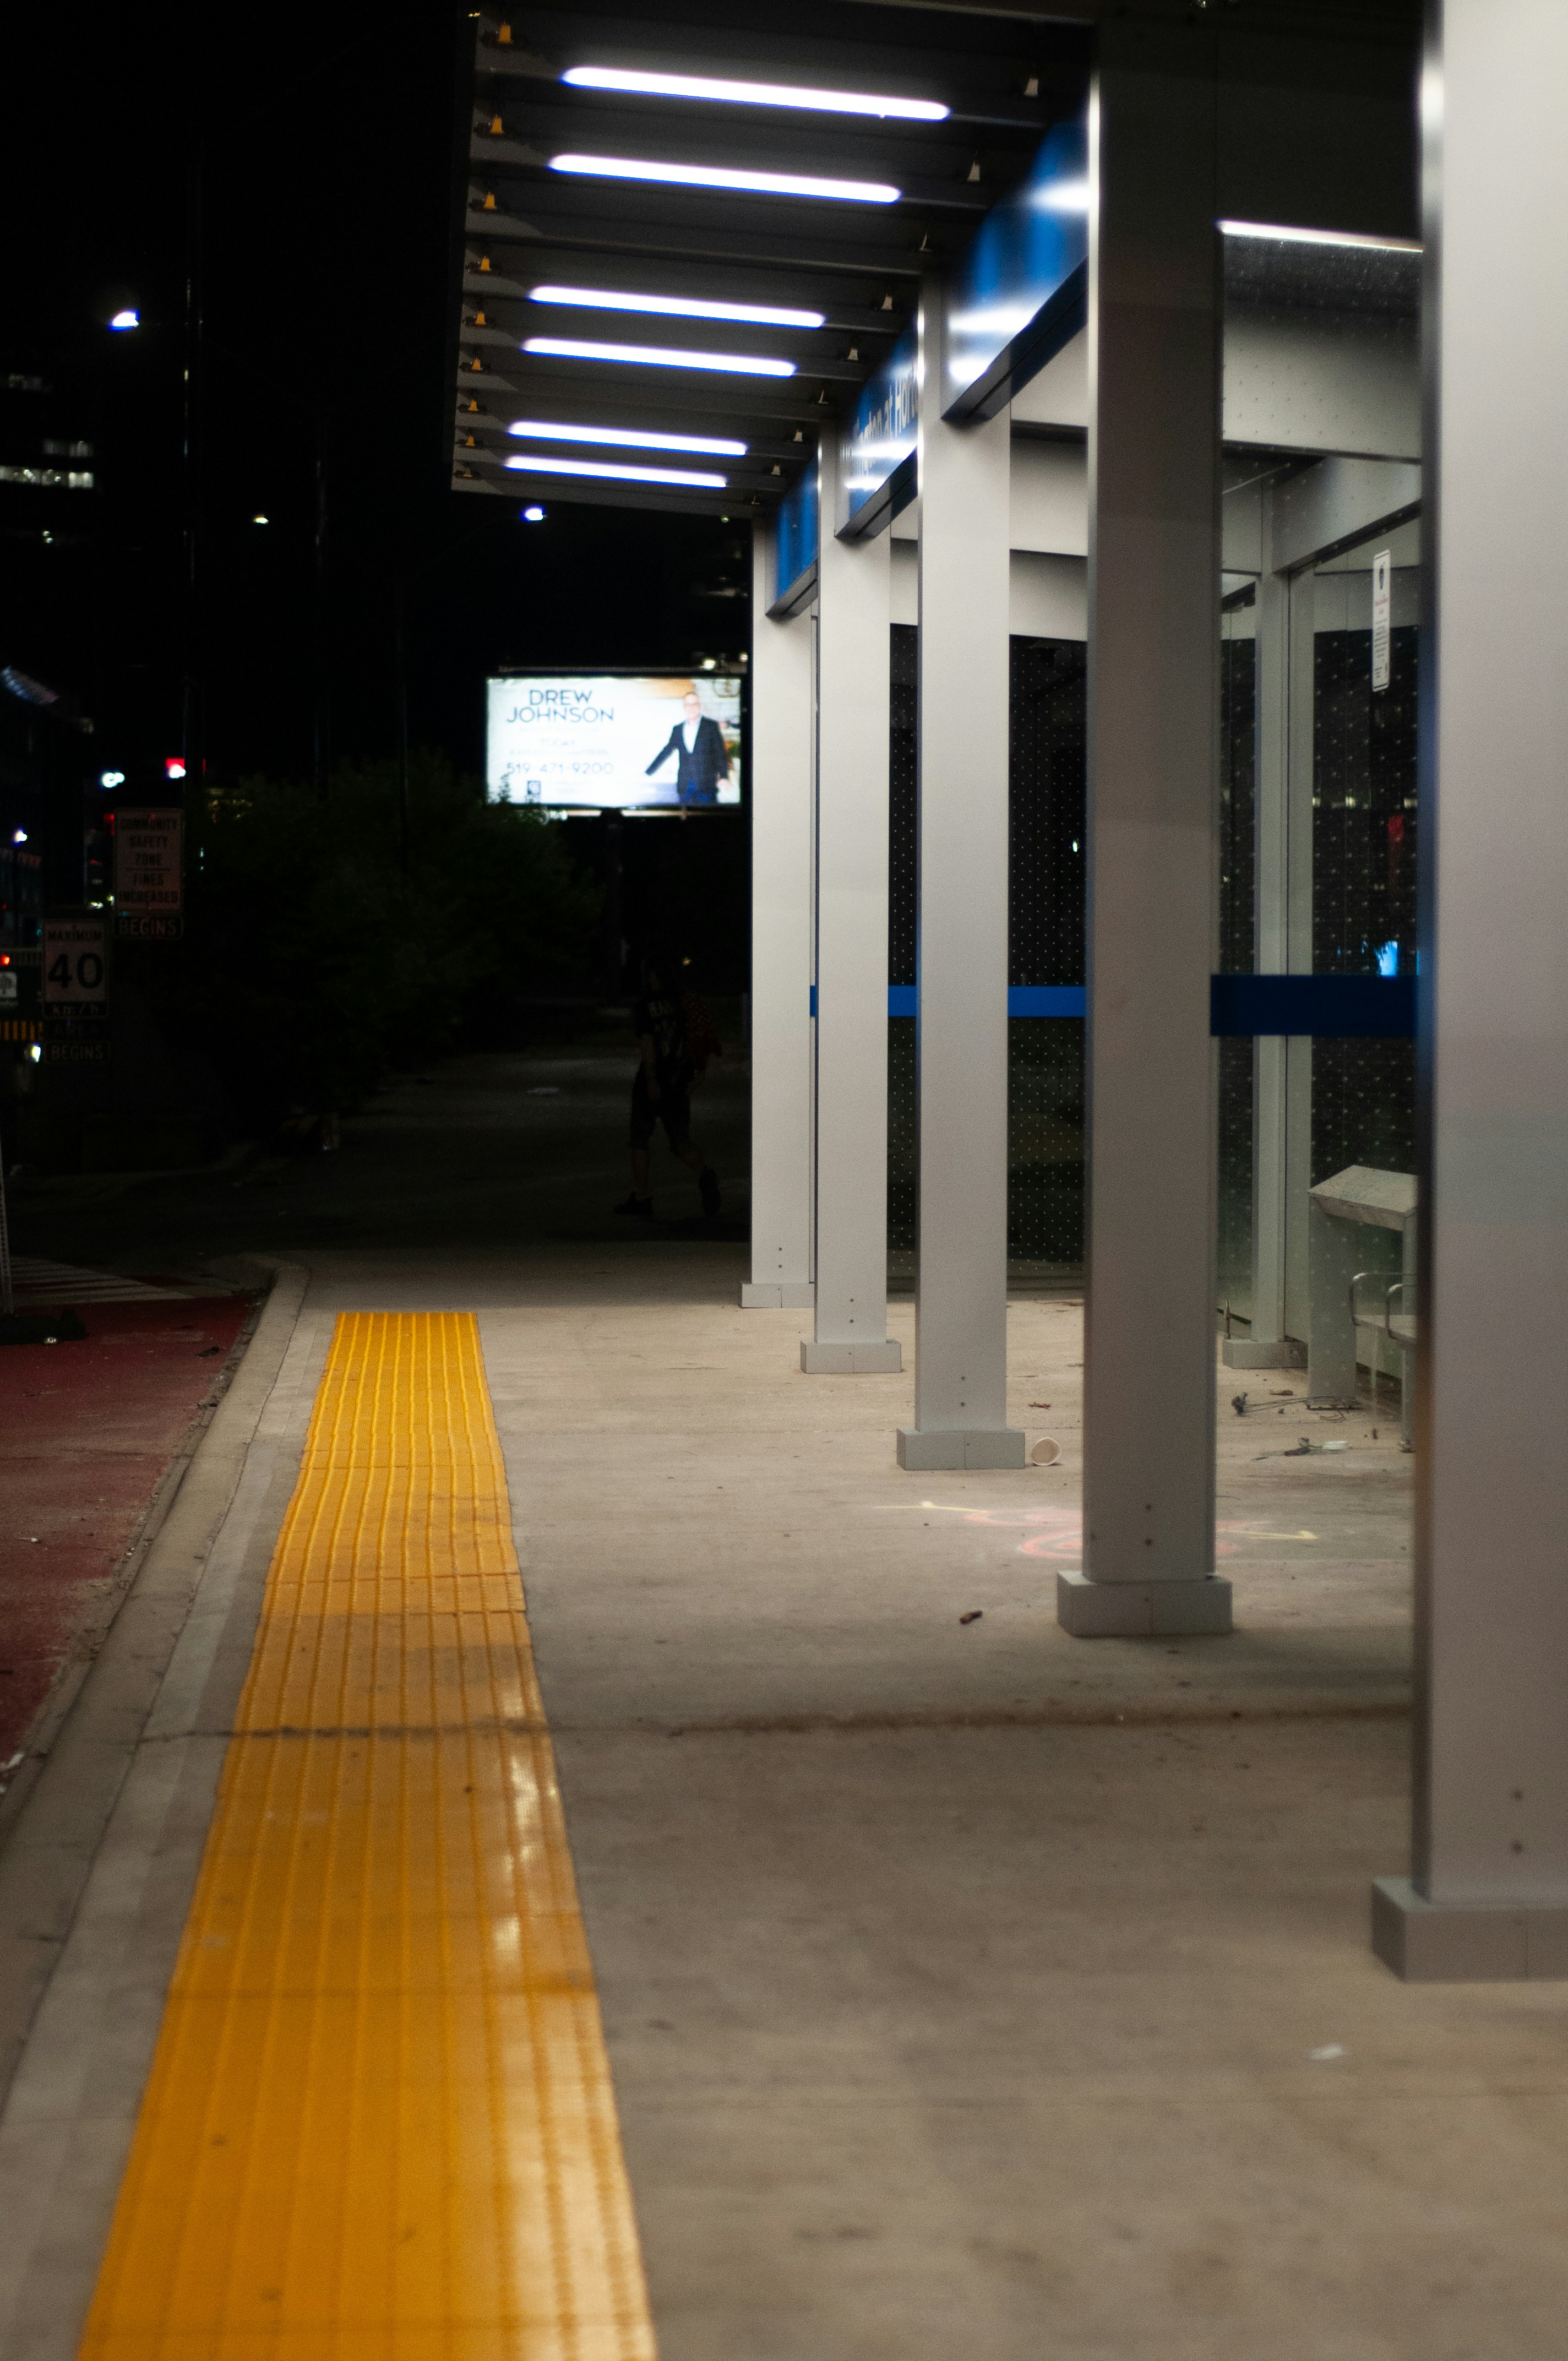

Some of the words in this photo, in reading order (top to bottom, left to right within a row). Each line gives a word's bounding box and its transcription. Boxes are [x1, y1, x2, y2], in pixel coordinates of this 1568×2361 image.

[529, 689, 592, 705] DREW
[506, 707, 614, 722] JOHNSON
[540, 738, 575, 747] TODAY
[120, 818, 177, 830] COMMUNITY
[129, 836, 167, 848] SAFETY
[135, 853, 162, 866] ZONE
[133, 873, 164, 885] FINES
[119, 891, 178, 903] INCREASED
[119, 918, 177, 936] BEGINS
[48, 930, 102, 941] MAXIMUM
[48, 952, 103, 988] 40
[52, 1004, 99, 1015] km/h
[51, 1045, 104, 1060] BEGINS
